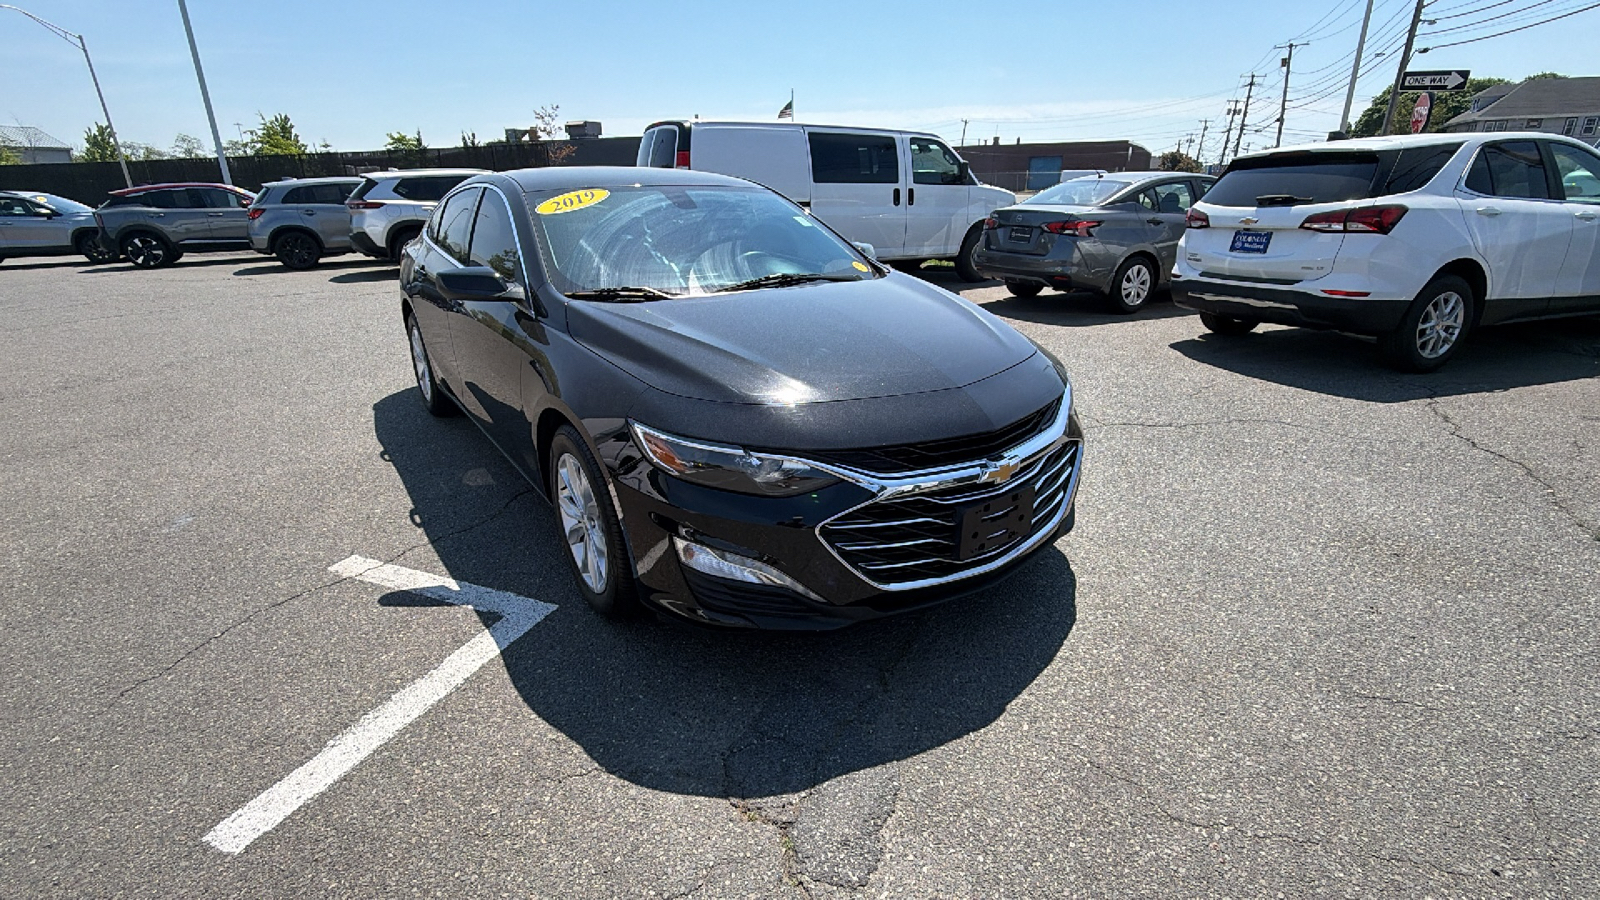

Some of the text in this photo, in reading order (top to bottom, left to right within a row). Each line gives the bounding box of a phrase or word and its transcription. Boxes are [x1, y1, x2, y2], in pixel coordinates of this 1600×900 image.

[1408, 76, 1449, 85] ONE WAY
[1412, 106, 1428, 121] STOP
[550, 191, 595, 212] 2019
